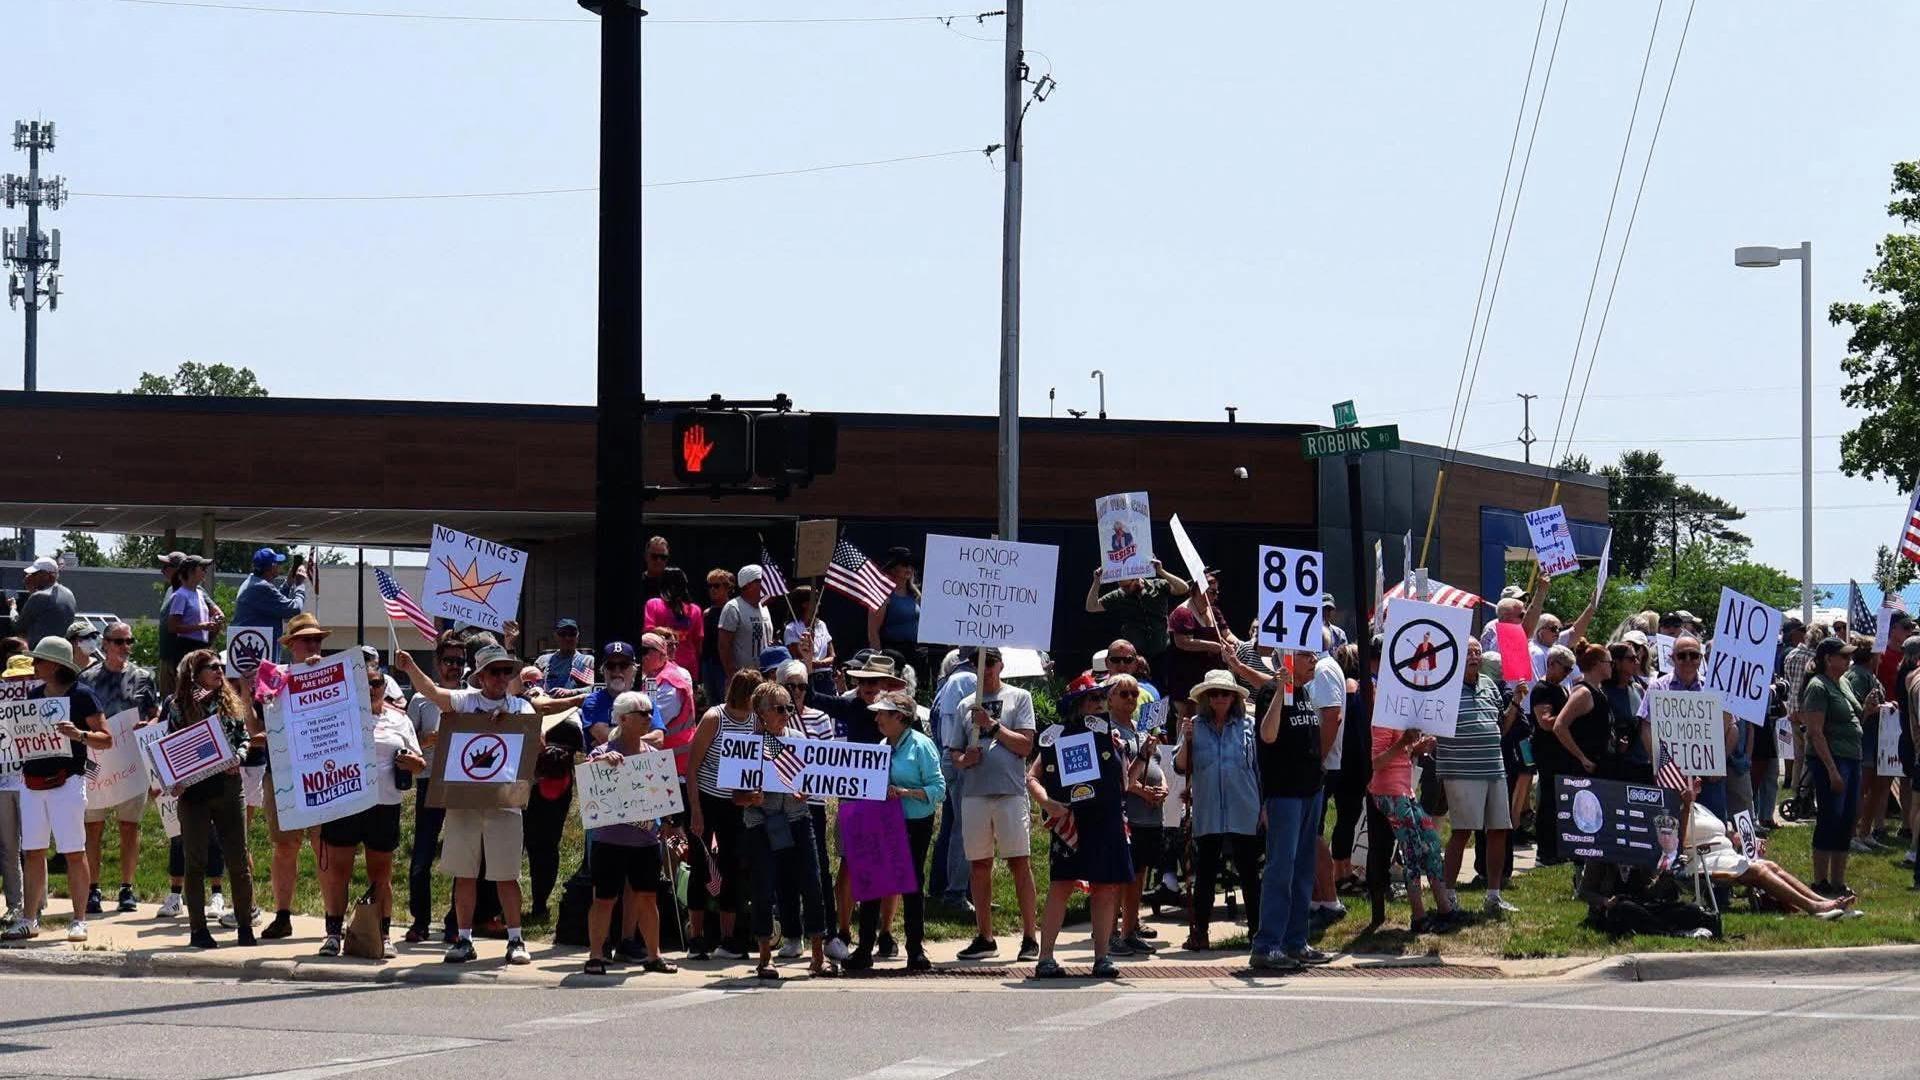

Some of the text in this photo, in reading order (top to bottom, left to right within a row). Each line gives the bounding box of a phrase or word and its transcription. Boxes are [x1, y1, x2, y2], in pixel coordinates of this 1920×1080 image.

[1307, 431, 1370, 455] ROBBINS
[436, 526, 519, 563] NO KINGS
[1108, 545, 1137, 560] RESIST
[960, 547, 1019, 567] HONOR
[978, 567, 1000, 580] THE
[1263, 550, 1319, 597] 86
[942, 580, 1038, 604] CONSTITUTION
[441, 601, 499, 628] SINCE 1776
[968, 602, 1004, 618] NOT
[955, 619, 1014, 640] TRUMP
[1261, 600, 1318, 647] 47
[1723, 598, 1769, 645] NO
[613, 642, 622, 653] B
[293, 665, 338, 682] PRESIDENTS
[301, 675, 334, 690] ARE NOT
[1710, 651, 1765, 701] KING
[299, 687, 340, 706] KINGS
[1384, 694, 1446, 721] NEVER
[1655, 696, 1714, 720] FORCAST
[14, 723, 37, 735] over
[310, 731, 338, 742] STRONGER
[320, 723, 339, 732] PEOPLE
[1657, 720, 1712, 740] NO MORE
[14, 731, 61, 758] profit
[303, 750, 322, 760] PEOPLE
[330, 743, 349, 752] POWER
[313, 741, 327, 749] THAN
[721, 738, 760, 760] SAVE
[803, 745, 888, 770] COUNTRY!
[1064, 747, 1089, 758] LET'S
[1068, 761, 1089, 770] TACO
[1071, 755, 1083, 763] GO
[302, 764, 361, 793] NO KINGS
[589, 759, 652, 781] Hope Will
[740, 769, 763, 788] NO
[316, 779, 361, 806] AMERICA
[589, 783, 617, 796] Never
